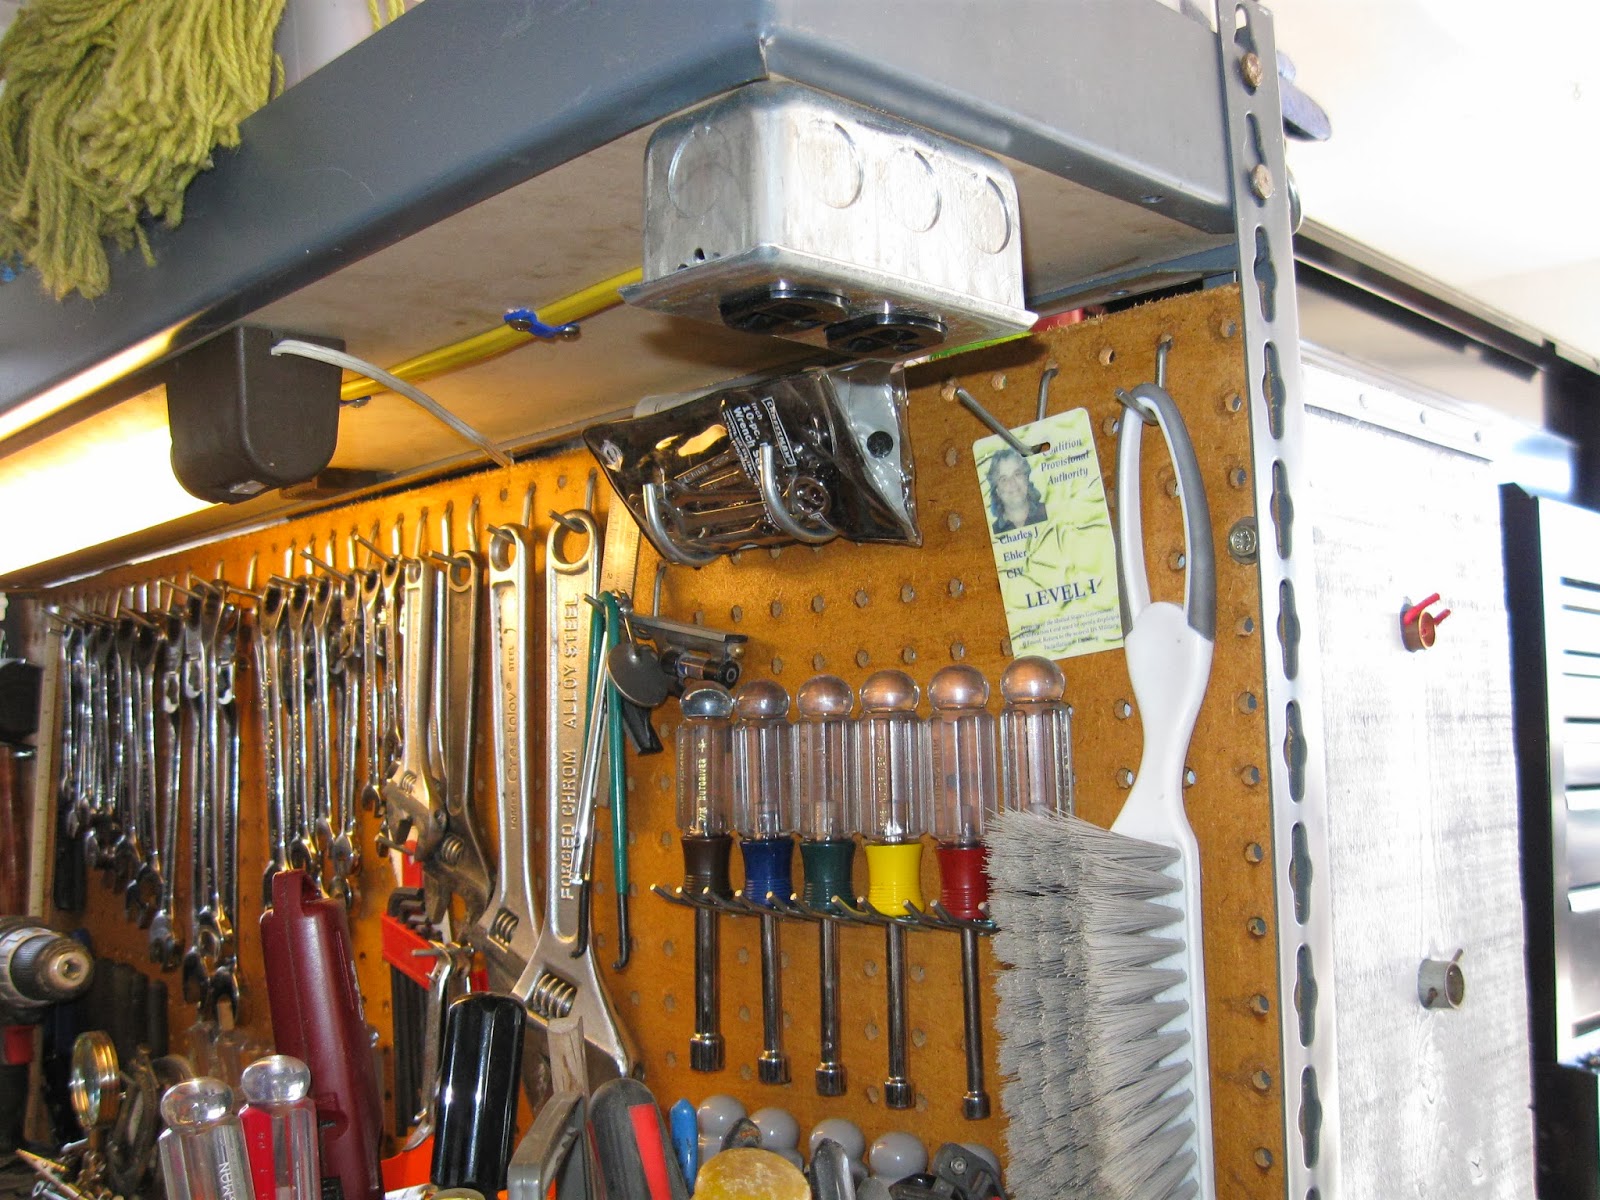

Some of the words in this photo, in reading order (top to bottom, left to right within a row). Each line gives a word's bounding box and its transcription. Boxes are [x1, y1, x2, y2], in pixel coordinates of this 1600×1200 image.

[733, 406, 756, 448] Wrench
[742, 405, 760, 439] 10-pc.
[766, 401, 791, 459] CRAFTSMAN
[1041, 450, 1089, 472] Provisional
[1048, 468, 1088, 485] Authority
[1000, 530, 1032, 545] Charles
[1003, 550, 1027, 562] Ehler
[1025, 582, 1085, 608] LEVEL
[563, 593, 578, 658] STEEL
[563, 664, 578, 728] ALLOY
[562, 749, 577, 816] CHROM
[218, 1162, 239, 1200] MAN
